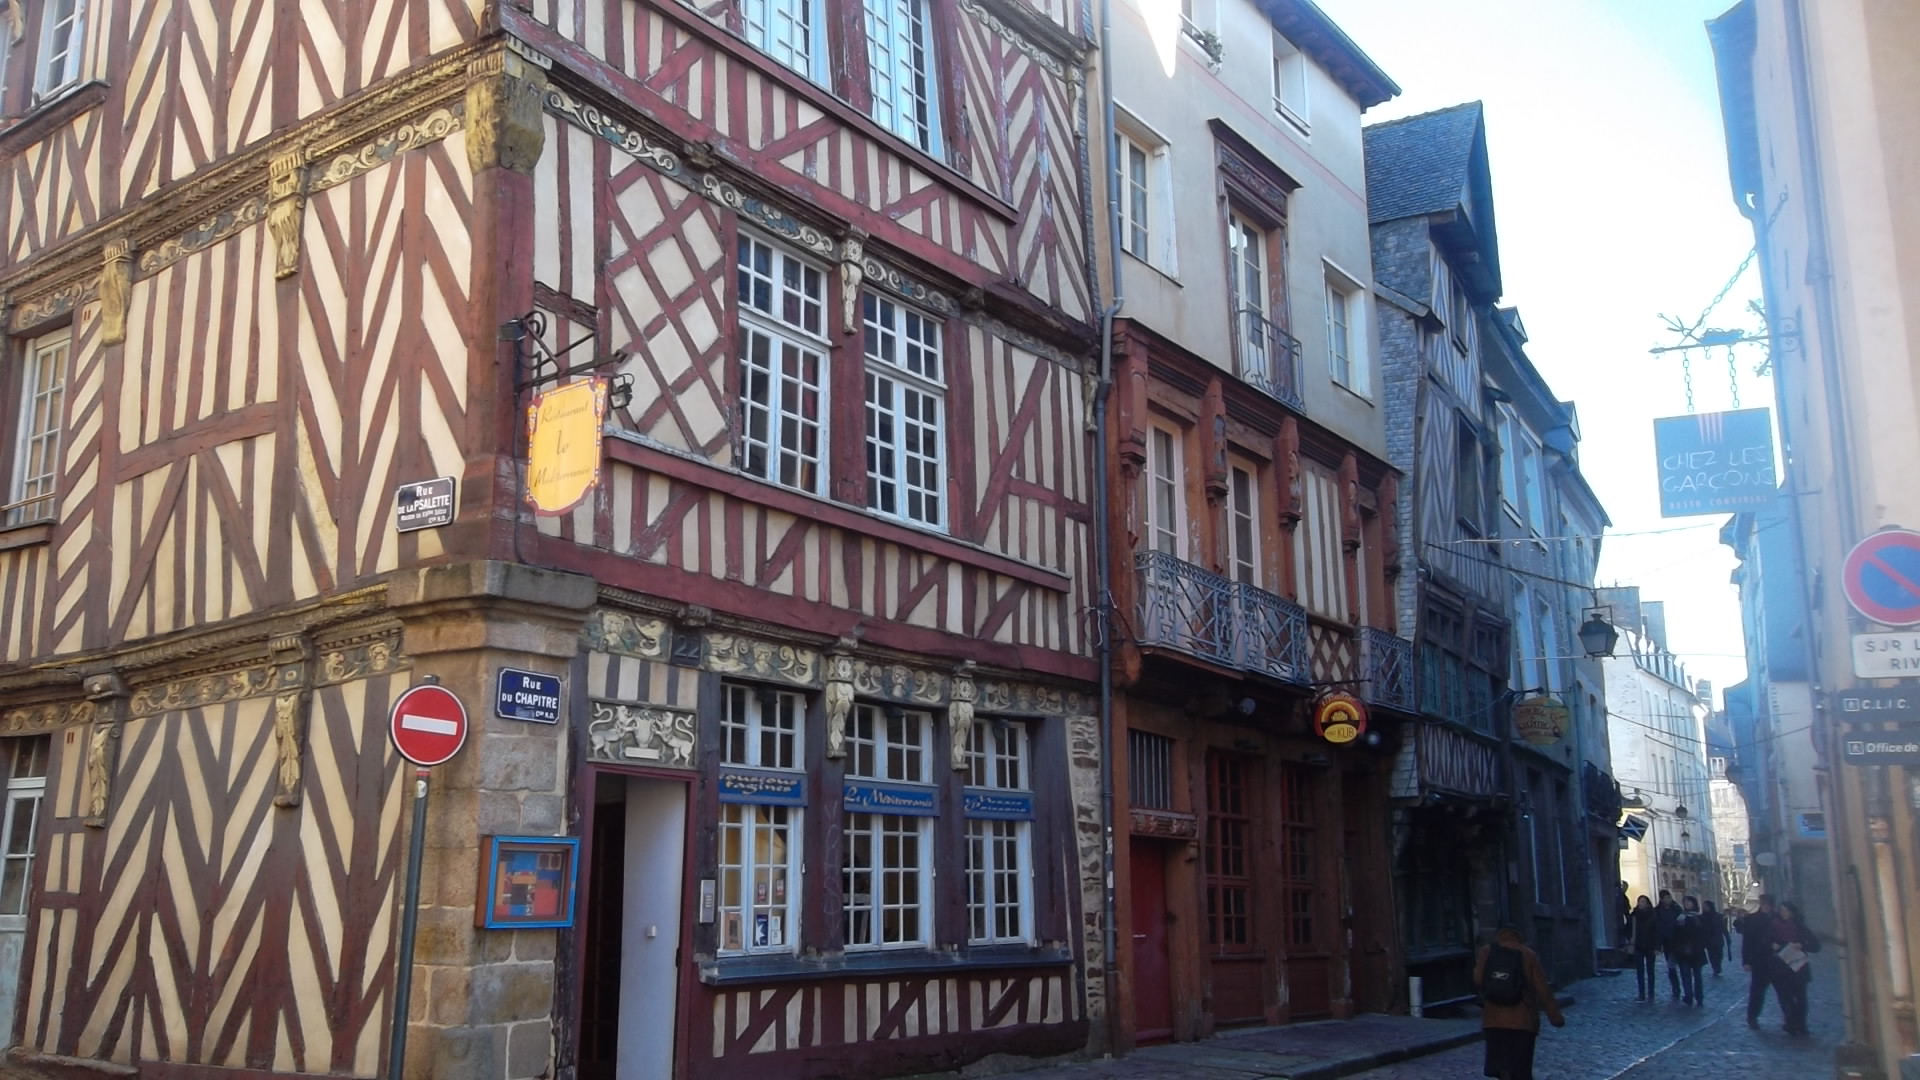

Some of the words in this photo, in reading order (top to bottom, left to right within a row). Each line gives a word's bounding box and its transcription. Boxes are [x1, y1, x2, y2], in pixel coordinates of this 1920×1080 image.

[541, 400, 589, 425] Restaurant
[1663, 450, 1718, 470] CHEZ
[1728, 445, 1767, 466] LES
[1662, 466, 1775, 493] GARÇONS
[397, 506, 406, 515] DE
[406, 504, 414, 513] LA
[413, 494, 450, 512] PSALETTE
[501, 692, 513, 703] DU
[515, 691, 558, 709] CHAPITRE
[1862, 699, 1911, 709] C.L.IC.
[1866, 742, 1903, 753] Office
[1904, 741, 1918, 752] de
